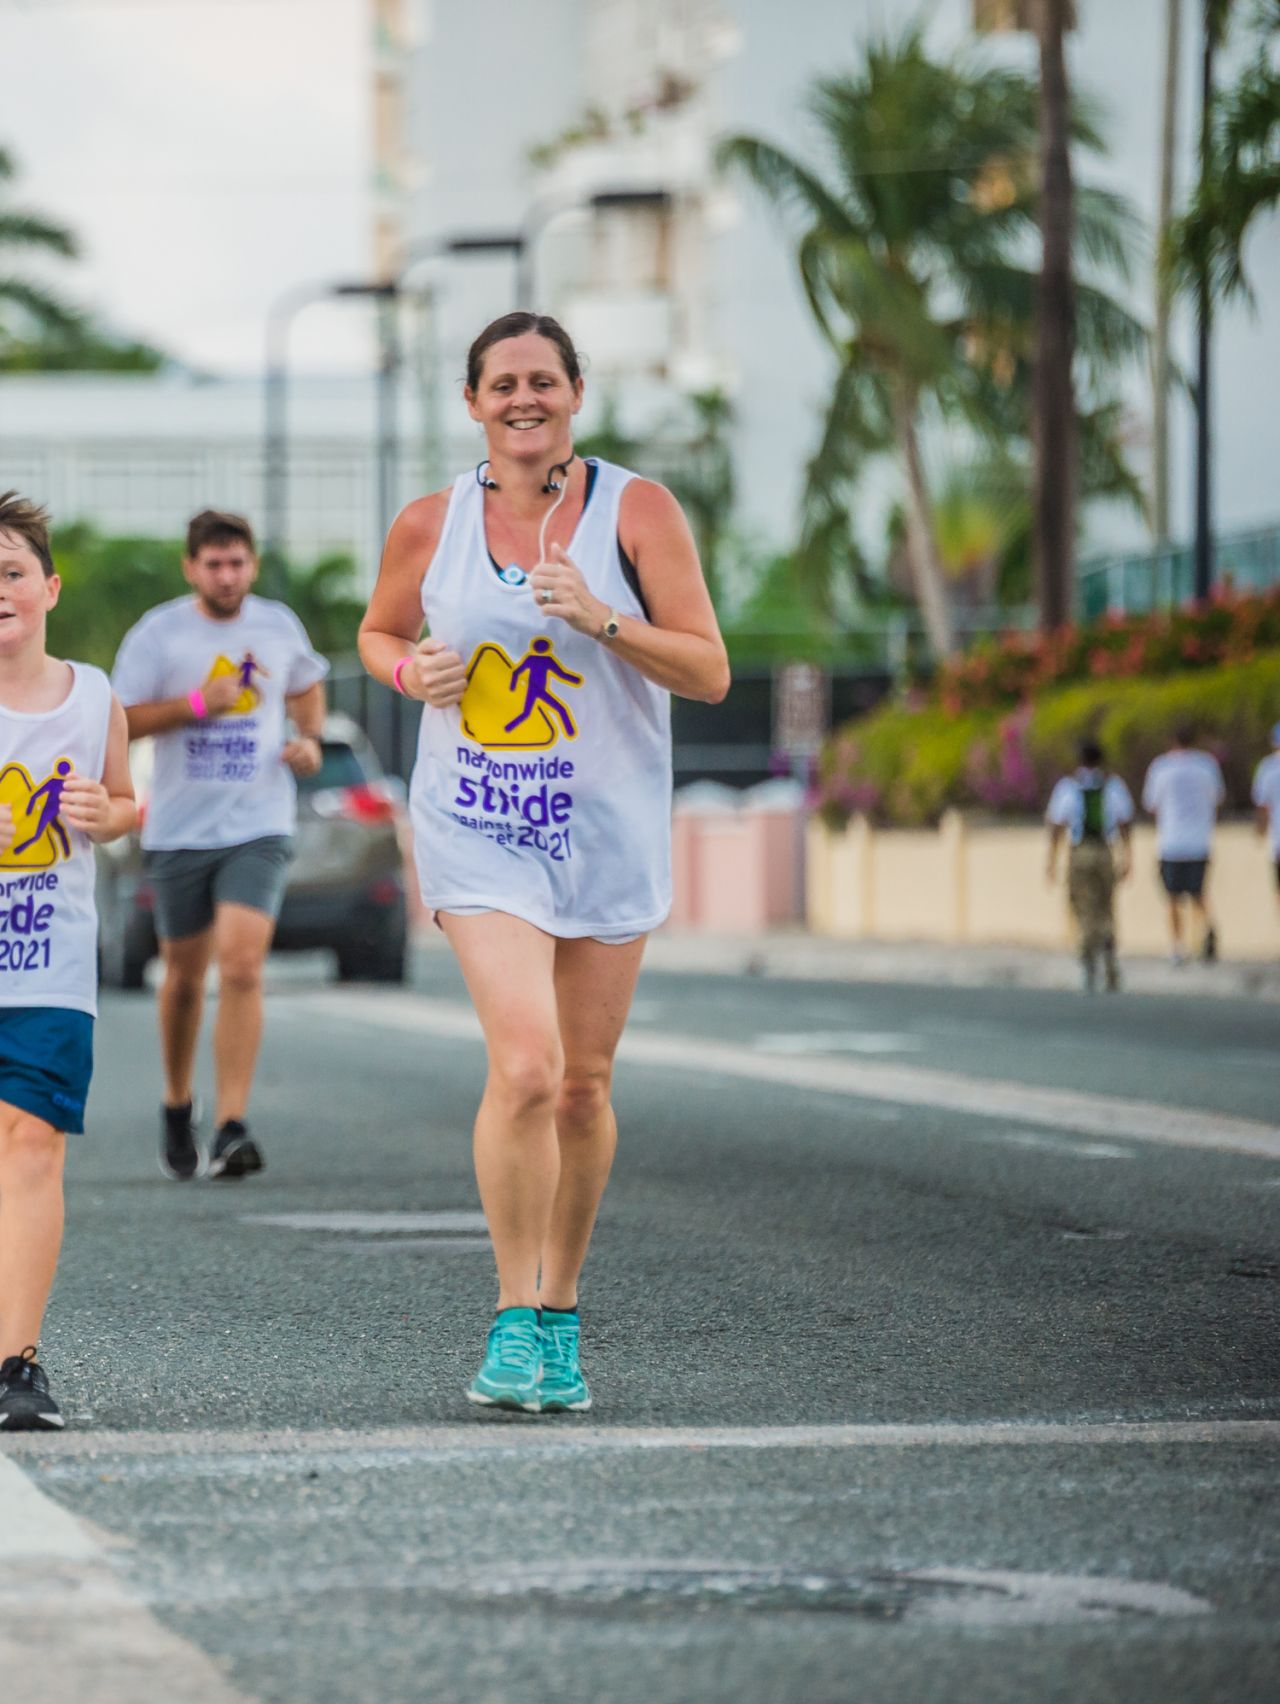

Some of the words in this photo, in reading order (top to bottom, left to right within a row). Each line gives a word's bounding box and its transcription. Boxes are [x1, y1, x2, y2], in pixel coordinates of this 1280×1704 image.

[457, 747, 574, 780] nationwide
[454, 774, 573, 827] stride
[452, 812, 512, 831] gainst
[517, 825, 572, 861] 2021
